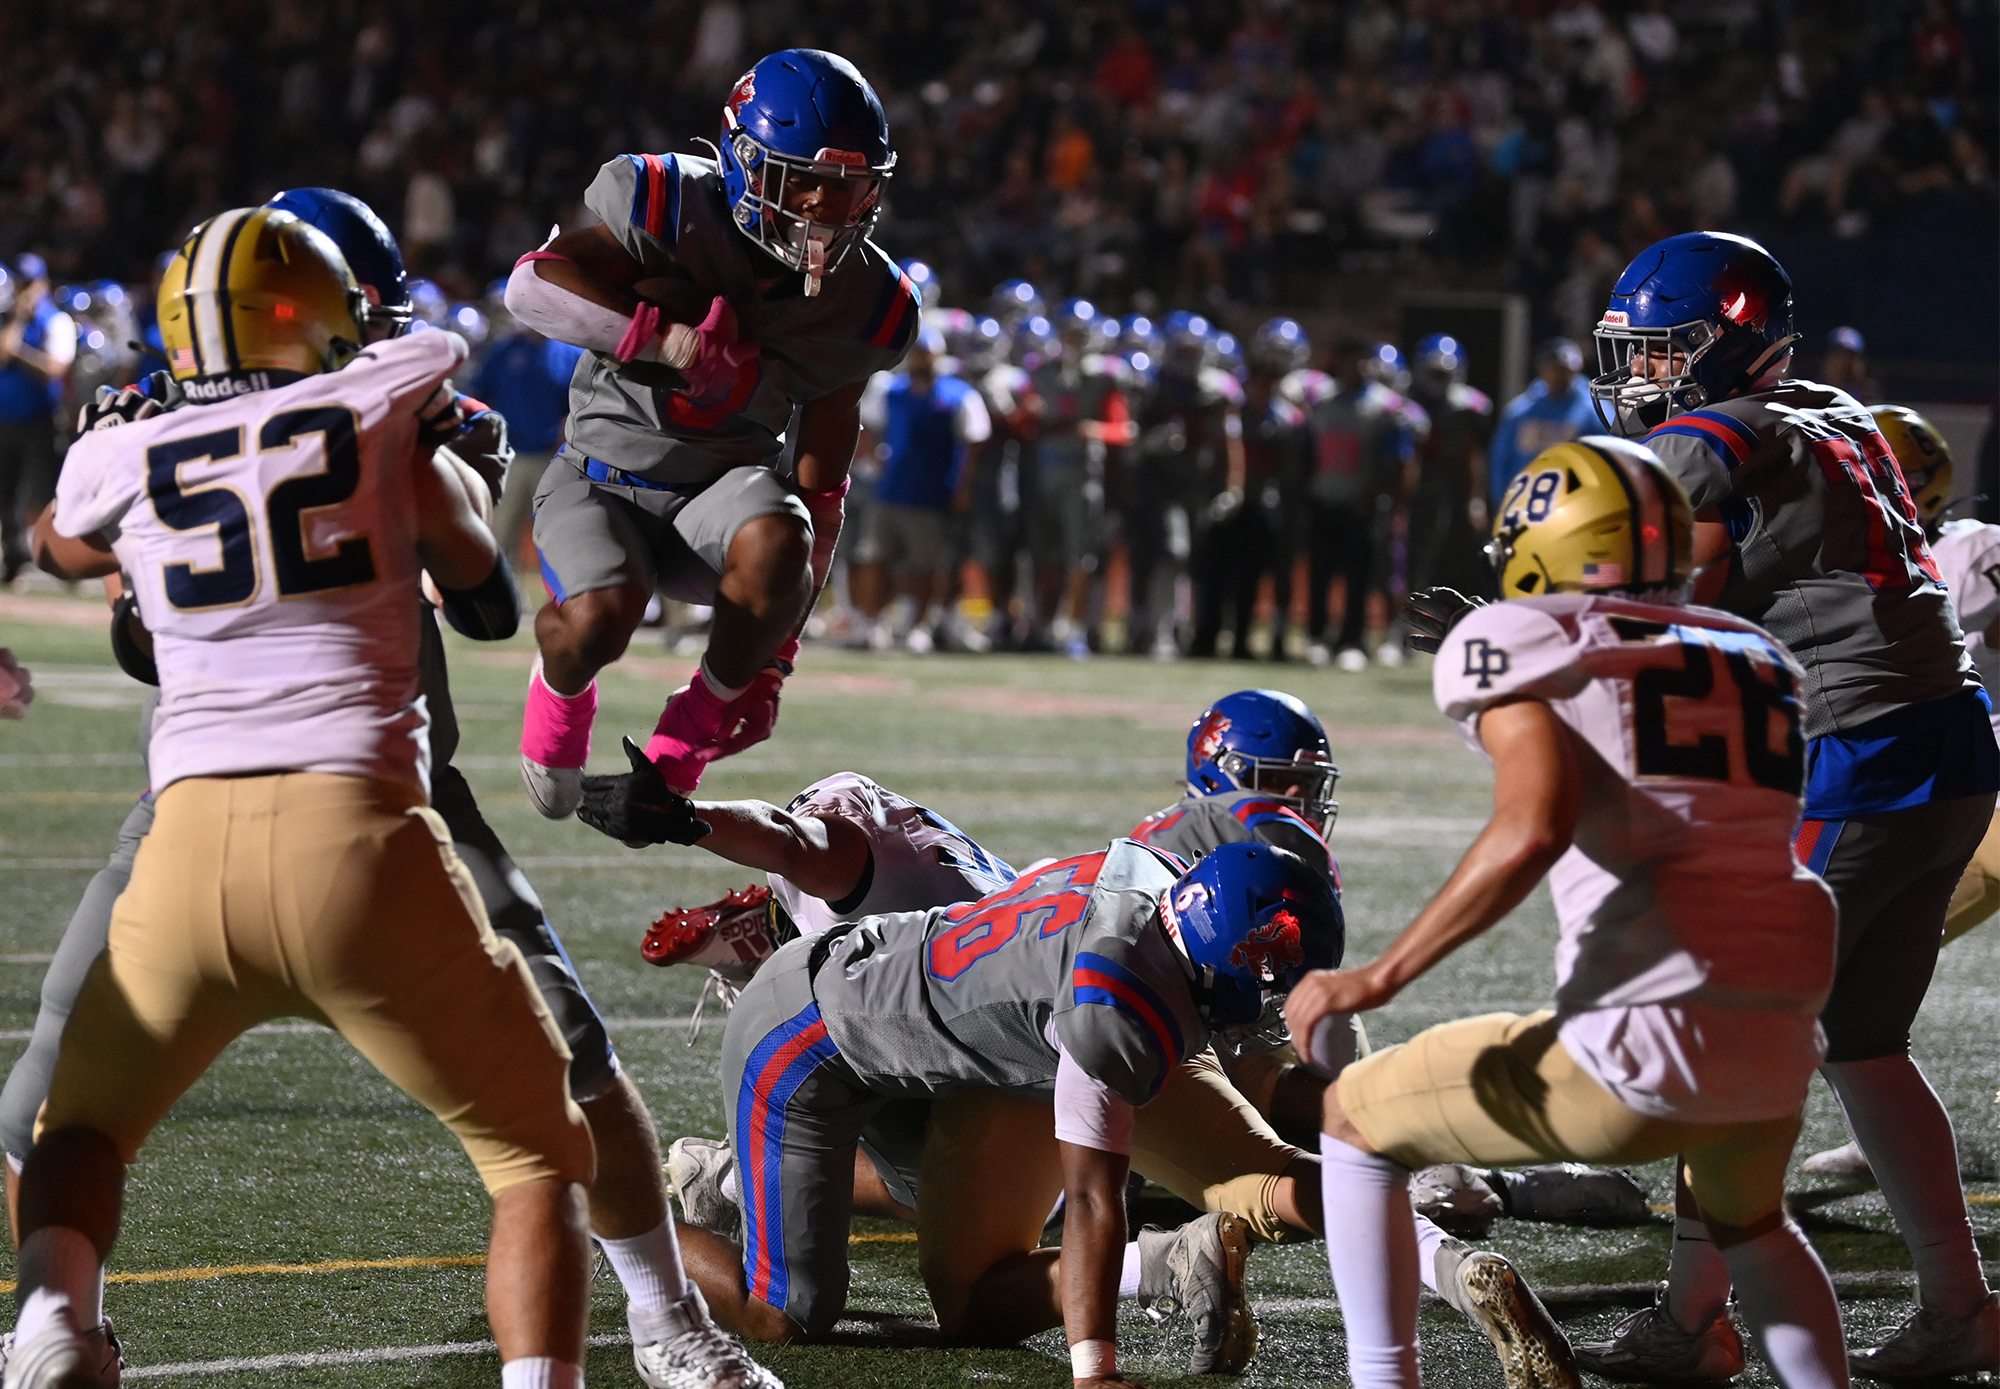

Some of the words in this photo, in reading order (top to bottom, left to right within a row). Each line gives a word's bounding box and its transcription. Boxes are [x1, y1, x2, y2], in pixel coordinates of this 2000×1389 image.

[825, 151, 863, 164] Riddell
[182, 371, 269, 400] Riddell
[145, 402, 375, 614] 52
[1501, 470, 1563, 529] 28
